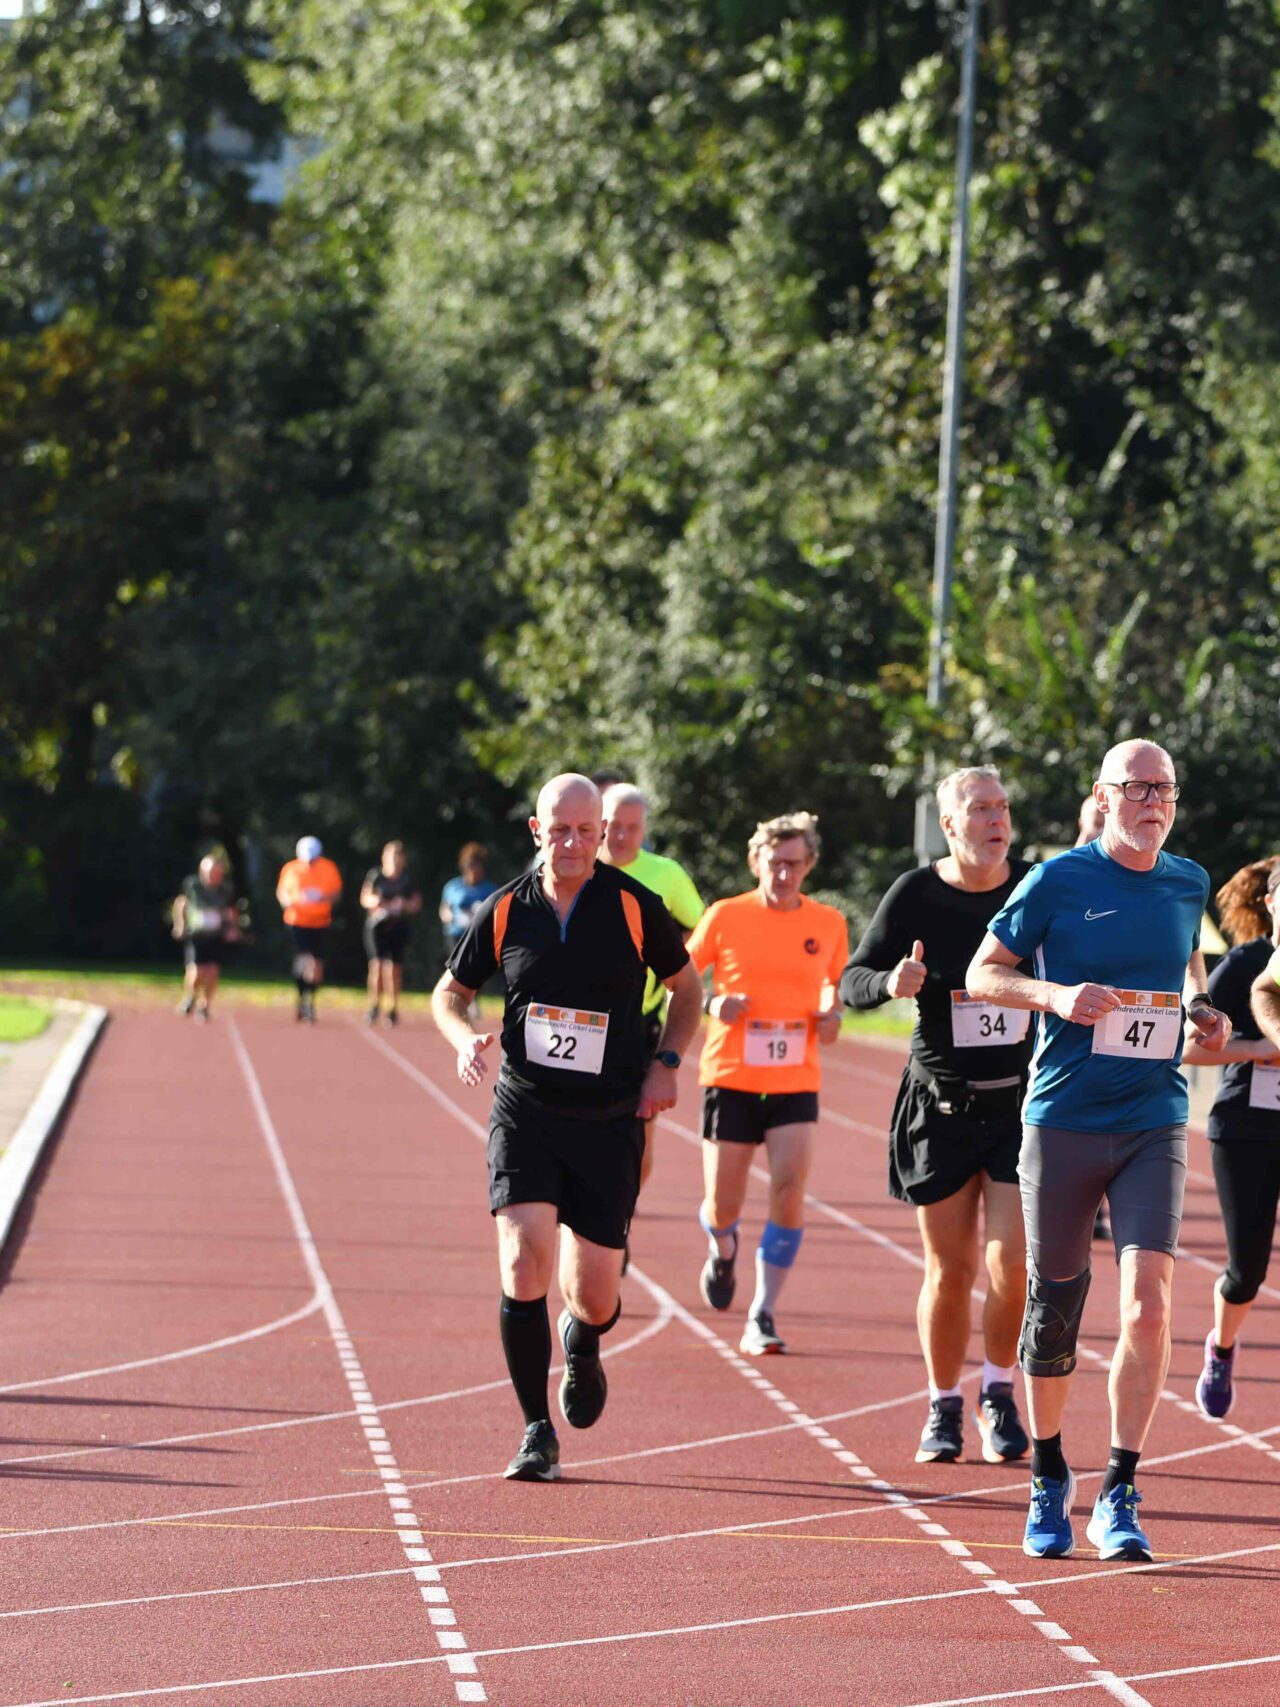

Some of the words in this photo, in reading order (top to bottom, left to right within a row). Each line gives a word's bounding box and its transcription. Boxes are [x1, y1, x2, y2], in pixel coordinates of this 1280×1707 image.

[979, 1011, 1007, 1037] 34
[1112, 1005, 1144, 1015] endrecht
[1146, 1007, 1164, 1015] Cirkel
[1165, 1008, 1179, 1017] Loop
[1124, 1019, 1156, 1048] 47
[546, 1033, 578, 1061] 22
[767, 1039, 788, 1060] 19
